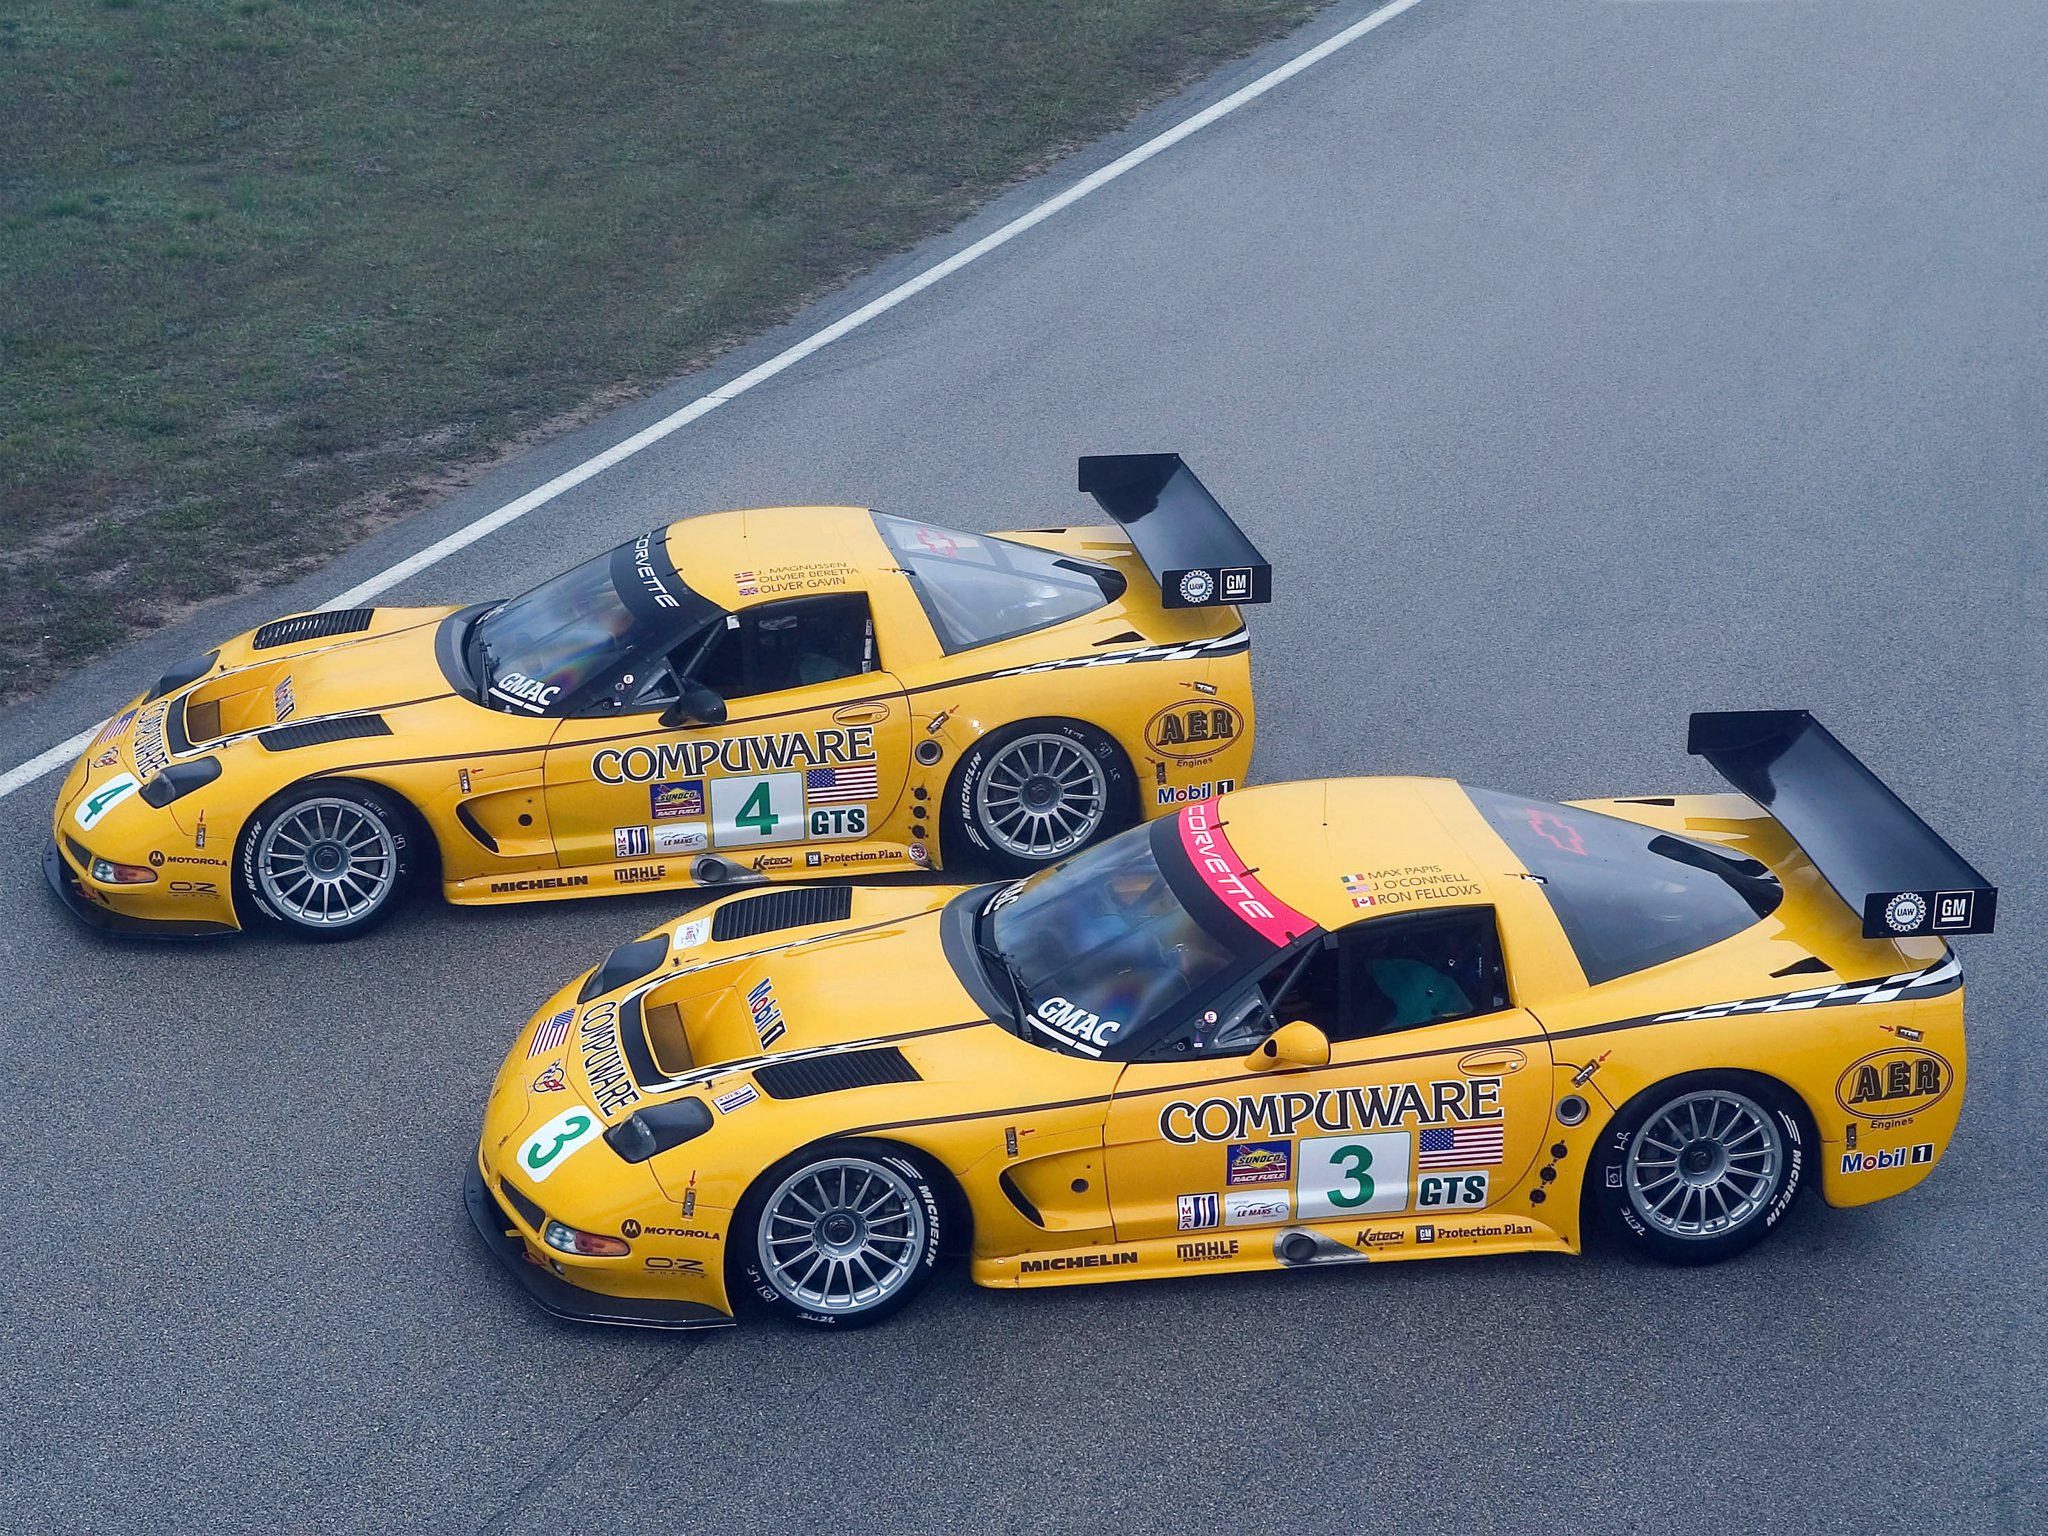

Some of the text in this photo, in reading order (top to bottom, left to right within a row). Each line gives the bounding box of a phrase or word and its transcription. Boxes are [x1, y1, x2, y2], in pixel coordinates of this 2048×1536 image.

[636, 531, 682, 610] CORVETTE
[758, 567, 860, 584] OLIVIER BERETTA
[760, 576, 847, 595] OLIVER GAVIN
[1226, 574, 1247, 590] GM
[499, 672, 561, 707] GMAC
[1156, 708, 1235, 746] AER
[592, 726, 879, 785] COMPUWARE
[1176, 757, 1214, 769] Engines
[660, 790, 696, 801] SUNOCO
[962, 751, 983, 821] MICHELIN
[1157, 783, 1211, 805] Mobil
[84, 781, 134, 823] 4
[735, 782, 779, 835] 4
[810, 808, 866, 837] GTS
[166, 855, 228, 867] MOTOROLA
[243, 820, 262, 891] MICHELIN
[823, 851, 877, 865] Protection
[878, 849, 903, 860] Plan
[1187, 804, 1275, 920] CORVETTE
[614, 865, 666, 881] MAHLE
[1368, 864, 1442, 880] MAX PAPIS
[1384, 873, 1470, 890] O'CONNELL
[491, 874, 588, 893] MICHELIN
[1378, 883, 1482, 905] RON FELLOWS
[1897, 907, 1915, 917] UAW
[1942, 898, 1967, 916] GM
[747, 977, 781, 1034] Mobil
[1038, 996, 1120, 1047] GMAC
[578, 1001, 640, 1118] COMPUWARE
[1847, 1058, 1941, 1105] AER
[1160, 1077, 1504, 1145] COMPUWARE
[1870, 1116, 1915, 1131] Engines
[527, 1115, 592, 1169] 3
[1238, 1154, 1281, 1166] SUNOCO
[1841, 1143, 1933, 1174] Mobil 1
[1233, 1172, 1286, 1183] RACE FUELS
[1328, 1144, 1375, 1210] 3
[1766, 1148, 1802, 1228] MICHELIN
[1419, 1175, 1486, 1206] GTS
[1181, 1198, 1192, 1229] IMSA
[1248, 1207, 1272, 1216] MANS
[643, 1226, 720, 1241] MOTOROLA
[917, 1184, 939, 1268] MICHELIN
[1437, 1223, 1533, 1239] Protection Plan
[1177, 1240, 1239, 1258] MAHLE
[1021, 1251, 1138, 1273] MICHELIN
